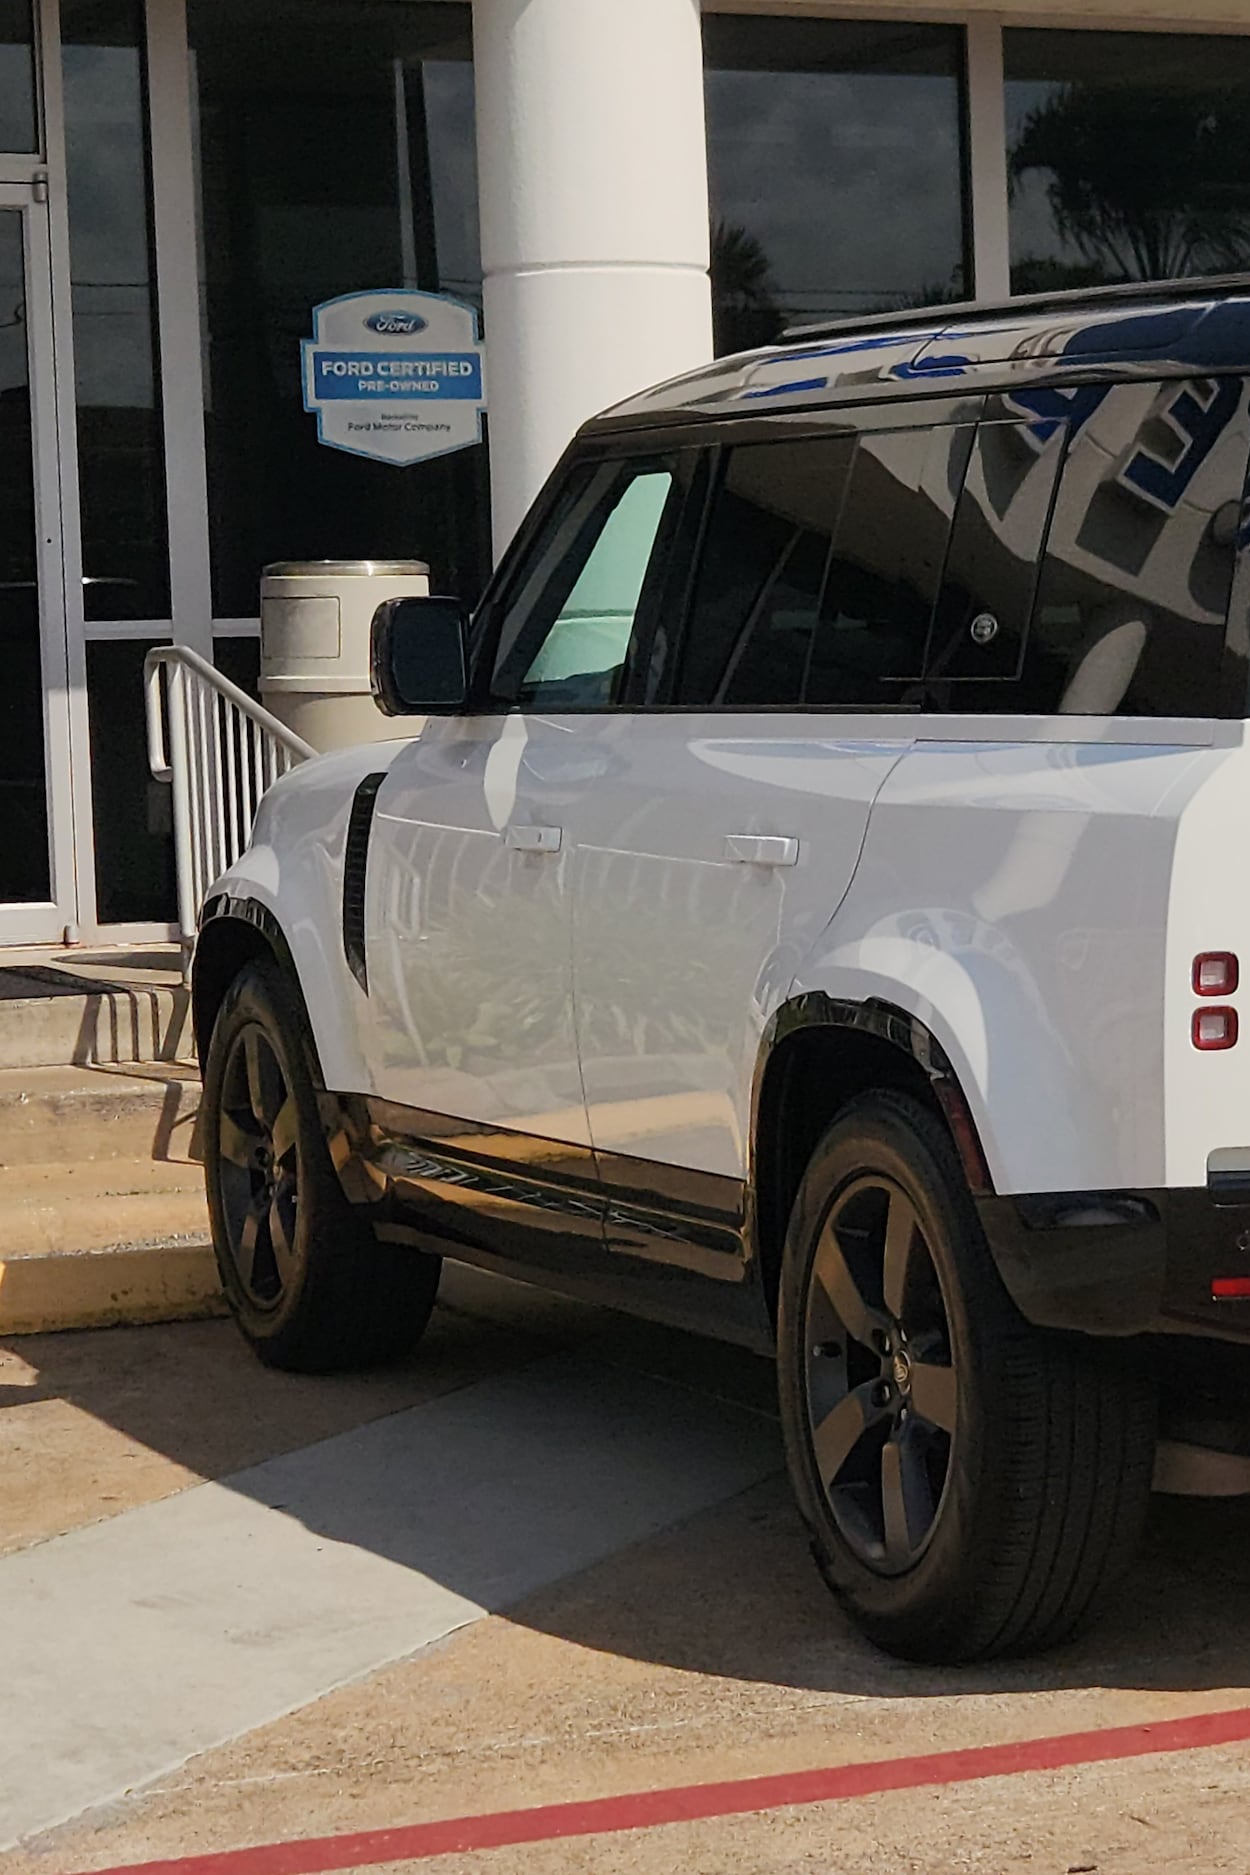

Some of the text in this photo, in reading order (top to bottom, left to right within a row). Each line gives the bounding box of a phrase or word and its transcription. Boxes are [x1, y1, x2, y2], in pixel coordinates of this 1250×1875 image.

[376, 314, 414, 332] Ford
[322, 362, 473, 376] FORD CERTIFIED
[358, 380, 440, 392] PRE-OWNED
[348, 422, 371, 432] Ford
[404, 422, 451, 433] Company
